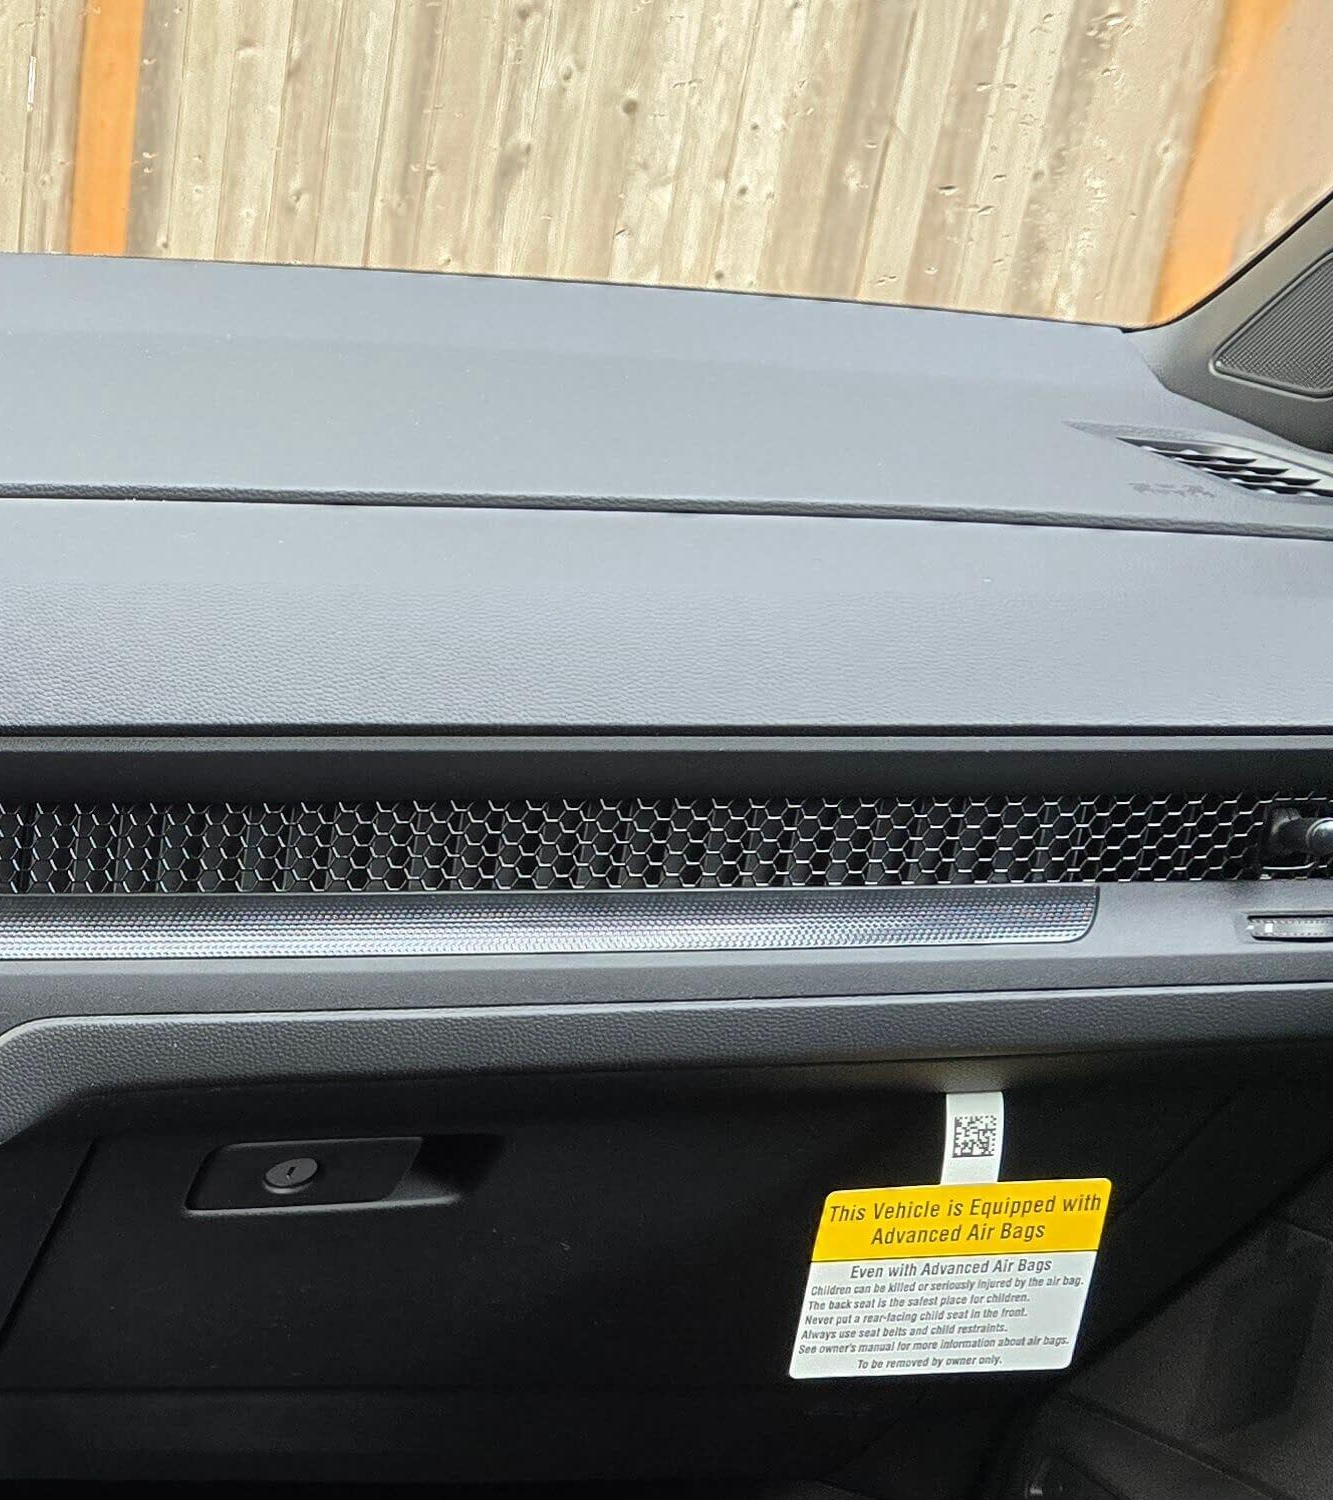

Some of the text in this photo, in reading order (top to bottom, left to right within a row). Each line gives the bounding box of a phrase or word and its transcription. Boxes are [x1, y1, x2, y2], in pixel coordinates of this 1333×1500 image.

[830, 1194, 1102, 1222] This Vehicle is Equipped with
[871, 1223, 1046, 1245] Advanced Air Bags
[850, 1258, 1053, 1279] Even with Advanced Air Bags
[811, 1274, 1084, 1296] Children can be killed or seriously injured by the air bag.
[809, 1293, 1030, 1310] The back seat is the safest place for children.
[805, 1307, 1028, 1326] Never put a rear-facing child seat in the front.
[801, 1323, 1008, 1341] Always use seat belts and child restraints.
[798, 1335, 1069, 1354] See owner's manual for more information about air bags.
[857, 1355, 1002, 1369] To be removed by owner only.
